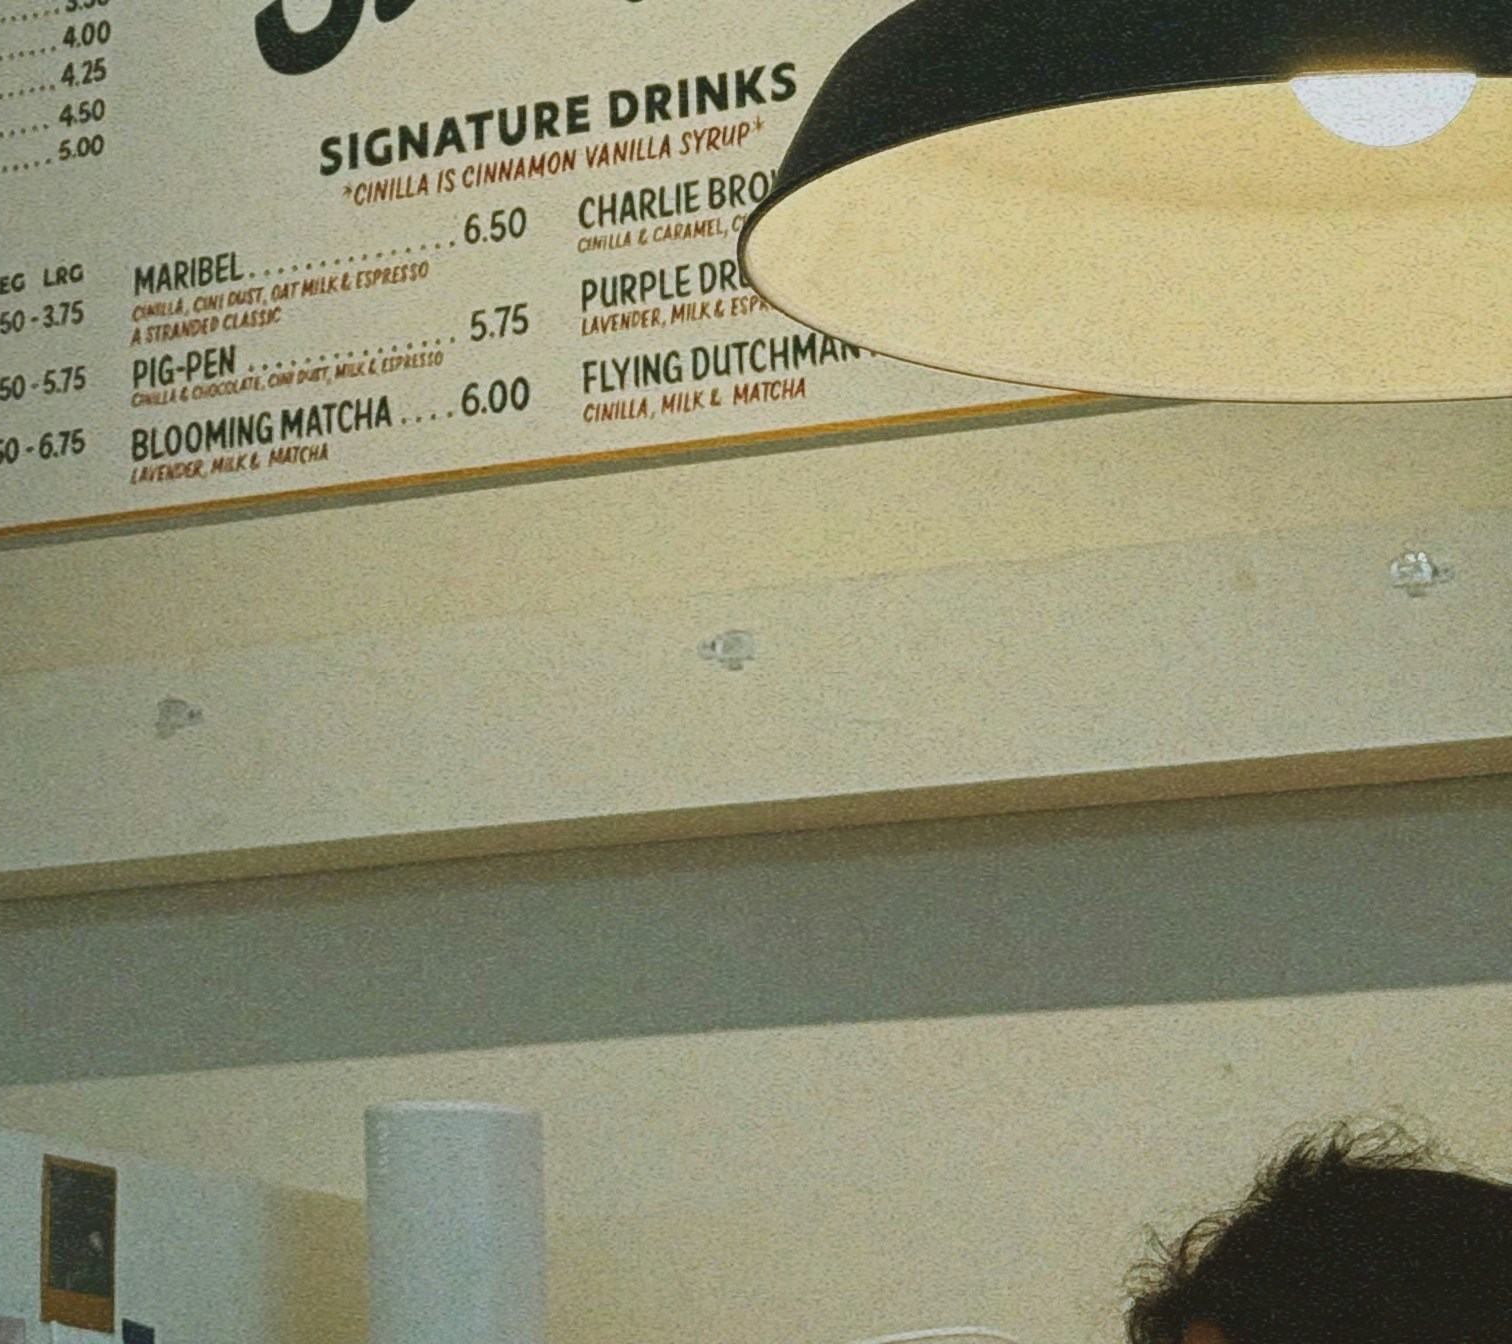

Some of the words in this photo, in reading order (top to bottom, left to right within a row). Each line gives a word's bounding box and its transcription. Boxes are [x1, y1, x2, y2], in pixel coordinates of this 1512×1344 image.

[61, 21, 111, 48] 4.00
[60, 57, 107, 87] 4.25
[59, 98, 106, 128] 4.50
[319, 94, 590, 176] SIGNATURE
[609, 61, 797, 129] DRINKS
[58, 134, 105, 162] 5.00
[437, 168, 455, 194] IS
[462, 148, 578, 189] CINNAMON
[585, 132, 672, 170] VANILLA
[578, 179, 701, 230] CHARLIE
[708, 168, 779, 211] BRO
[133, 251, 244, 296] MARIBEL
[464, 206, 526, 245] 6.50
[577, 230, 632, 254] CINILLA
[652, 217, 729, 245] CARAMEL,
[42, 263, 83, 288] LRG
[270, 281, 299, 300] OAT
[300, 274, 339, 297] MILK
[355, 260, 429, 290] ESPRESSO
[581, 264, 691, 313] PURPLE
[129, 326, 142, 347] A
[145, 315, 219, 345] STRANDED
[222, 306, 282, 331] CLASSIC
[581, 306, 667, 337] LAVENDER,
[670, 300, 711, 325] MILK
[713, 298, 725, 320] &
[730, 295, 772, 317] ESP
[132, 343, 236, 389] PIG-PEN
[469, 302, 529, 343] 5.75
[335, 359, 366, 377] MILK
[380, 350, 444, 375] ESPRESSO
[582, 349, 683, 395] FLYING
[691, 332, 861, 382] DUTCHMAN
[131, 410, 274, 462] BLOOMING
[280, 394, 393, 441] MATCHA
[461, 375, 531, 418] 6.00
[582, 401, 656, 425] CINILLA,
[661, 393, 705, 415] MILK
[710, 388, 722, 408] &
[732, 377, 807, 406] MATCHA
[210, 455, 249, 475] MILK
[268, 442, 329, 469] MATCHA
